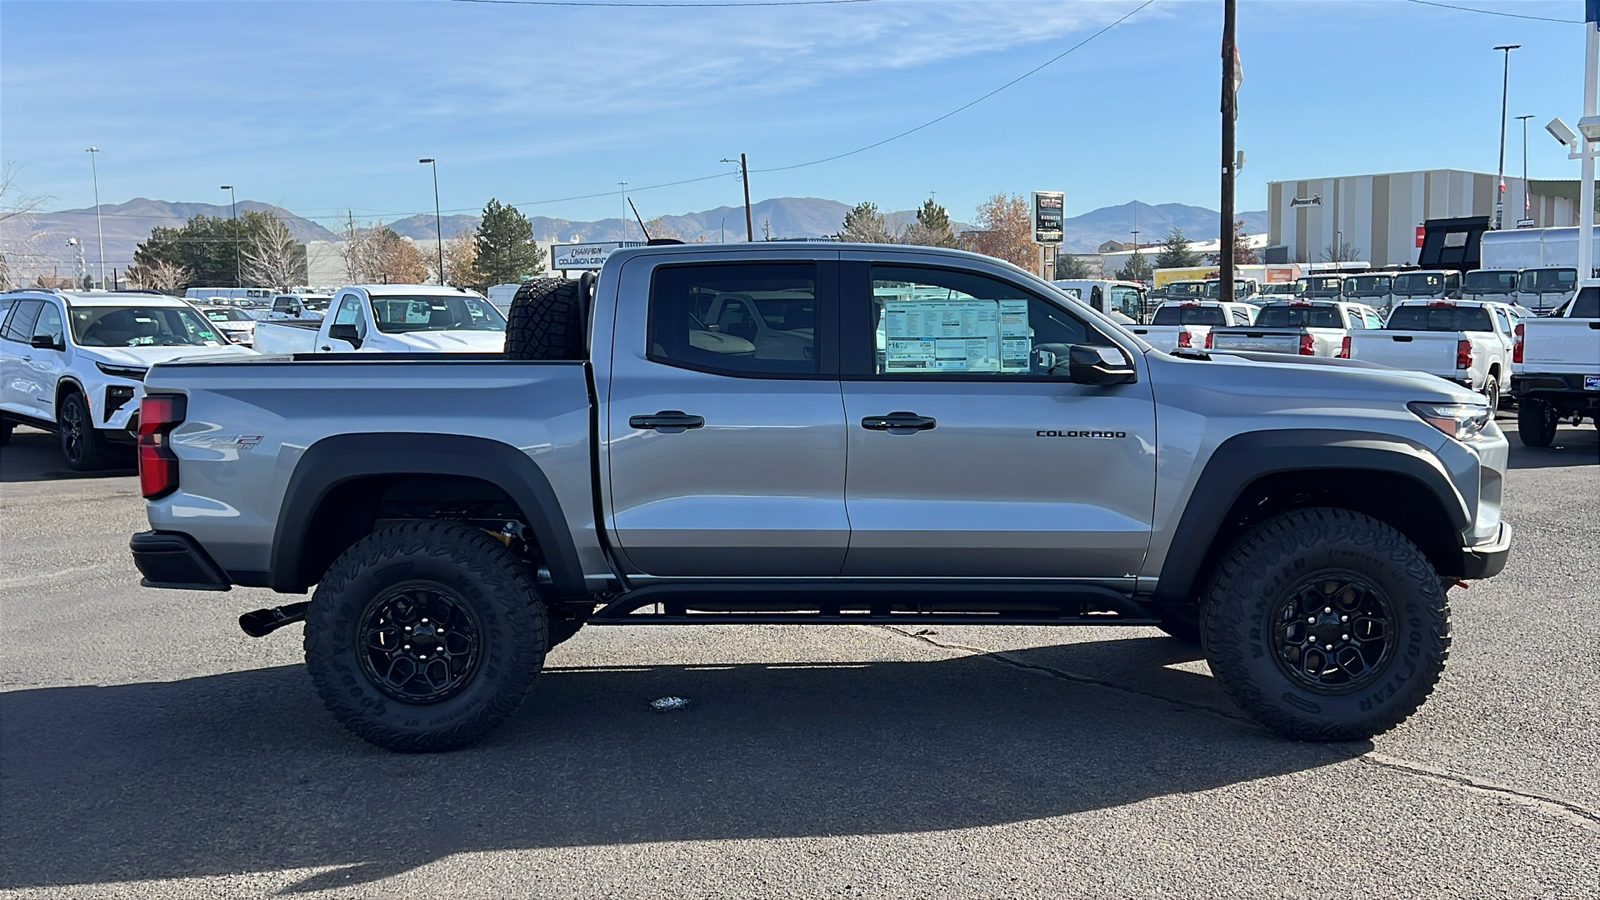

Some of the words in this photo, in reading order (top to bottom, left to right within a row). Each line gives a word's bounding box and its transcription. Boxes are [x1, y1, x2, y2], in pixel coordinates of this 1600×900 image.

[1040, 199, 1062, 208] GMC
[572, 247, 601, 257] CHAMPION
[1036, 430, 1127, 438] COLORADO
[1249, 557, 1307, 660] WRANGLER
[1358, 602, 1423, 712] GOODYEAR
